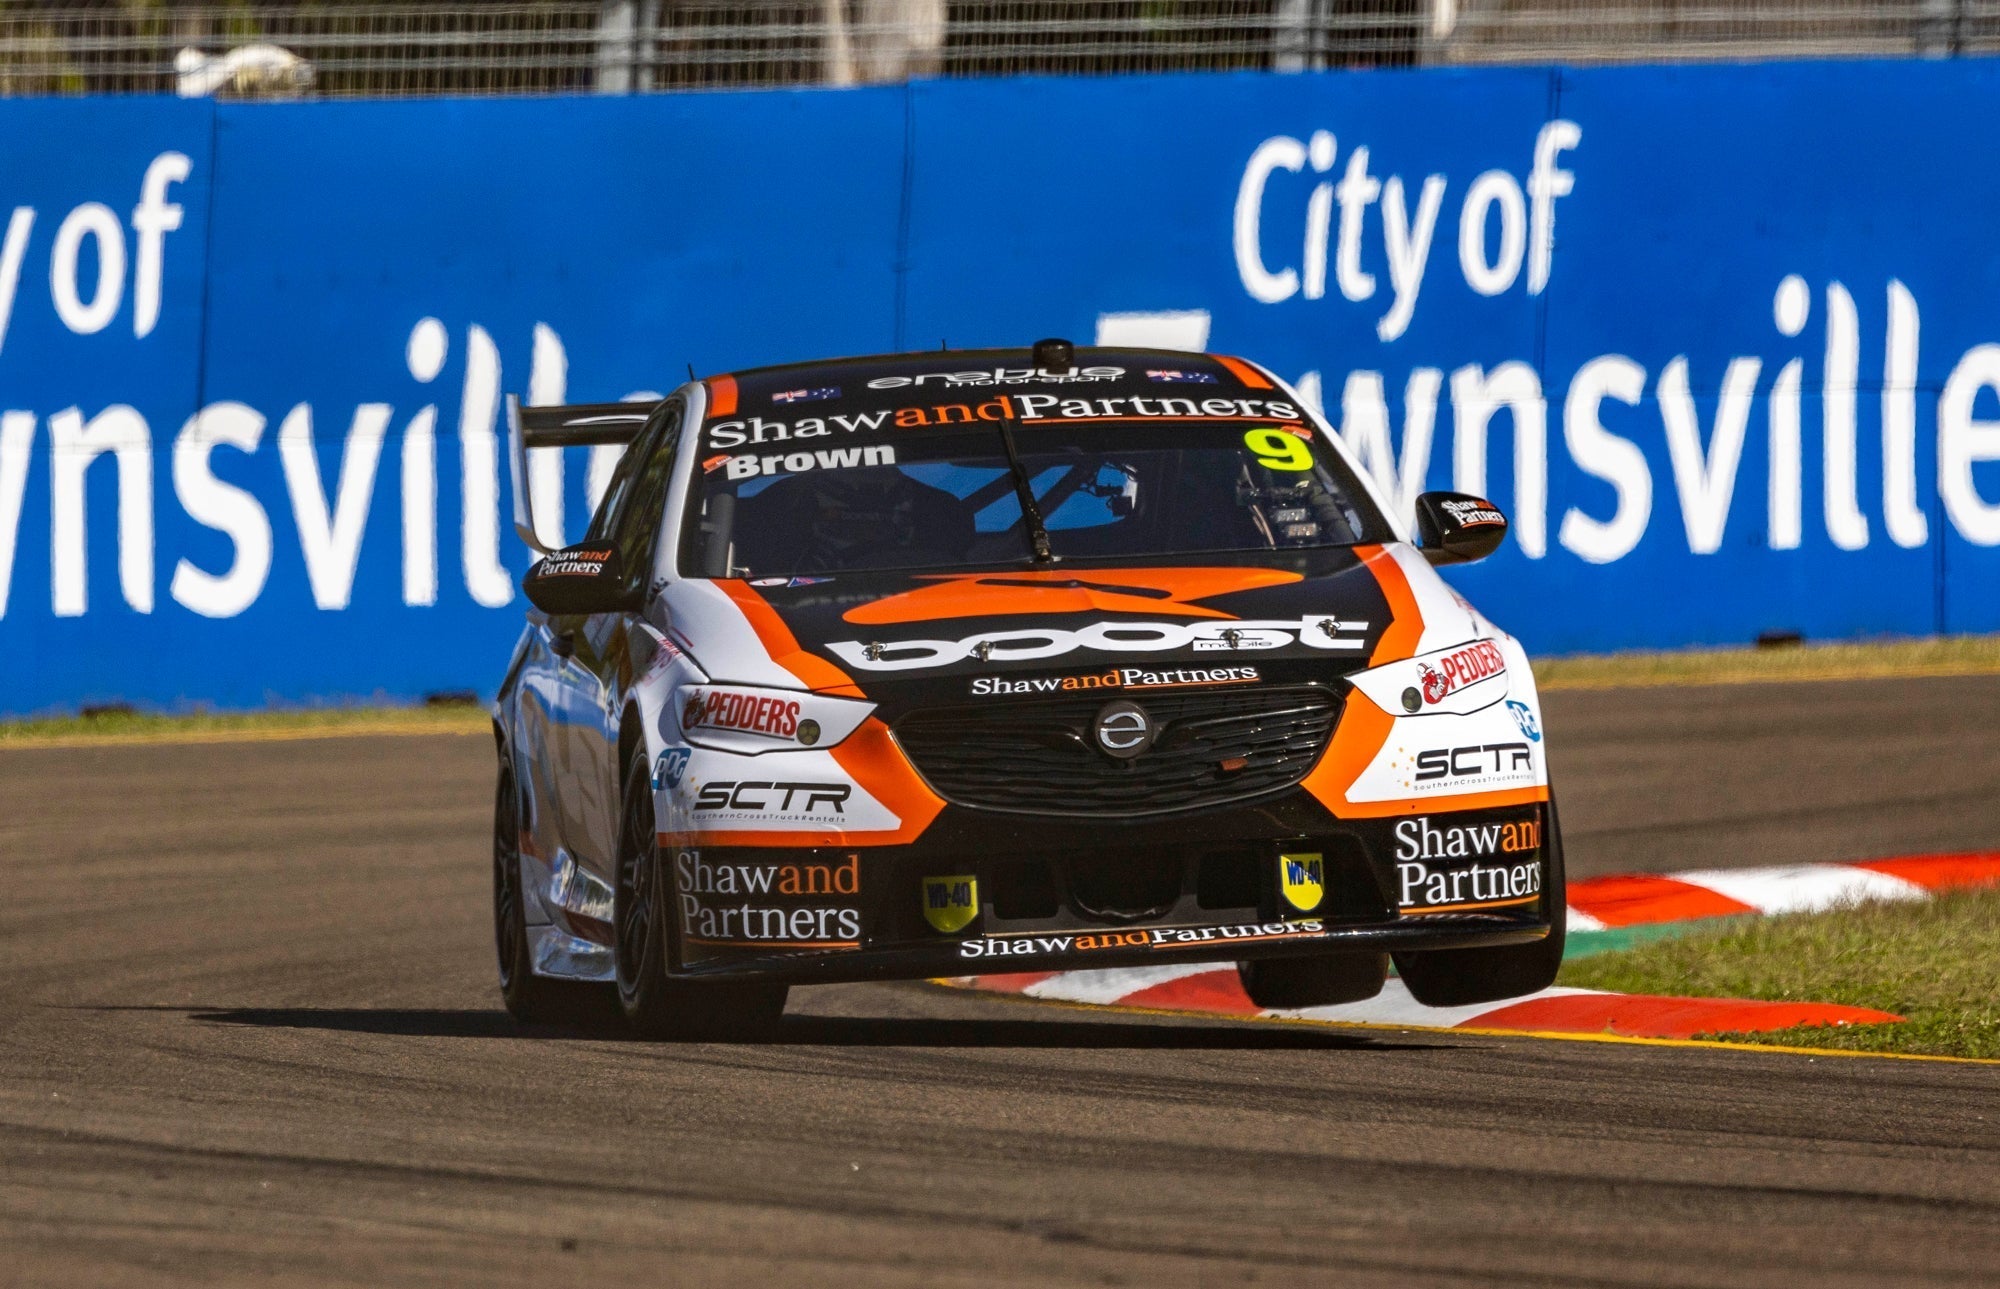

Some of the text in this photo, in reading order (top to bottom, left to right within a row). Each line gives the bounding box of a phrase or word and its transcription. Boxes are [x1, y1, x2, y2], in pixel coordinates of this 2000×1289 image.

[50, 151, 193, 339] of
[1232, 119, 1582, 342] City of
[726, 443, 896, 481] Brown
[1244, 428, 1314, 471] 9
[537, 559, 603, 577] Partners
[824, 614, 1370, 671] boost
[1441, 641, 1505, 690] PEDDERS
[704, 691, 801, 738] PEDDERS
[1415, 743, 1532, 781] SCTR
[694, 781, 852, 812] SCTR
[1285, 856, 1321, 887] WD-40
[1396, 860, 1541, 907] Partners
[680, 894, 860, 940] Partners
[927, 882, 972, 909] WD-40
